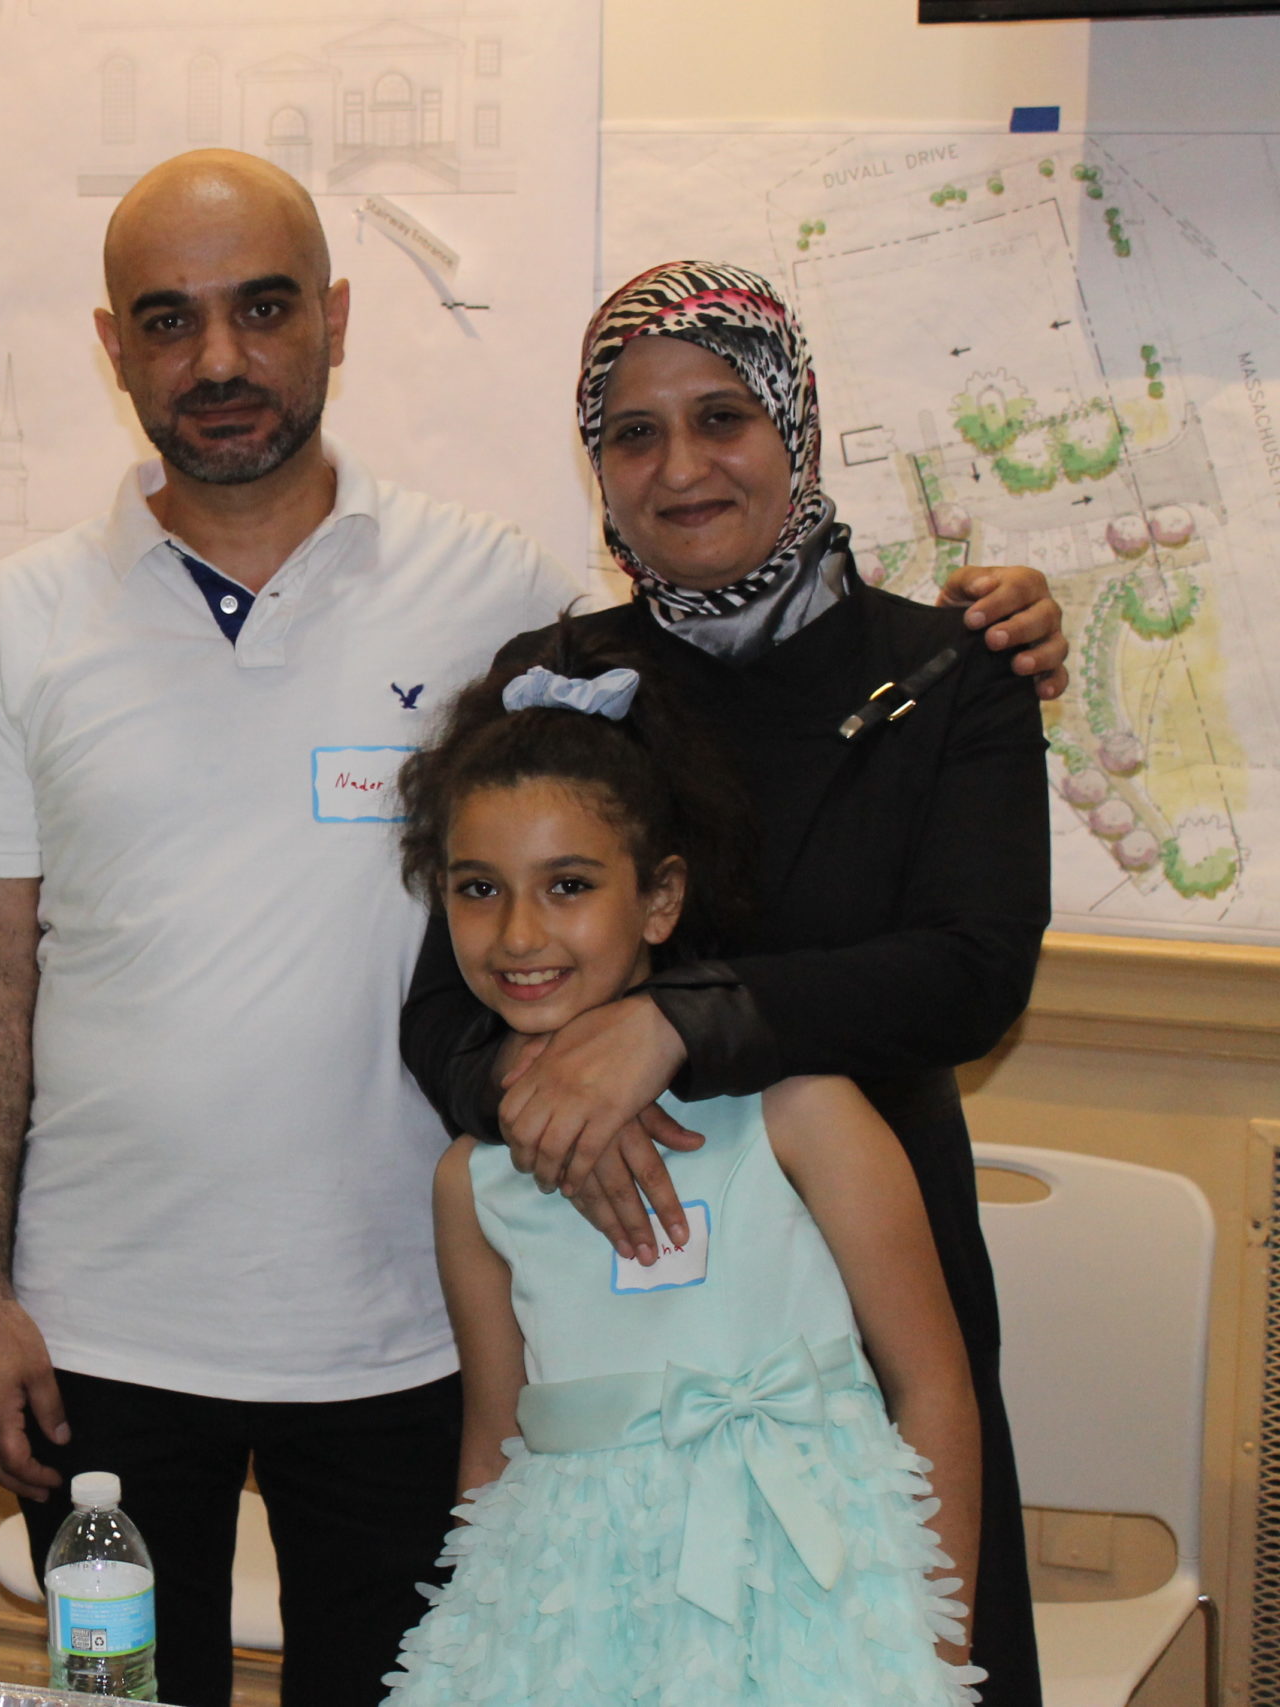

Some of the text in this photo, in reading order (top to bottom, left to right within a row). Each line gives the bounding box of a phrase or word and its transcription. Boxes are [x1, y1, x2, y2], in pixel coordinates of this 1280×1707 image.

[822, 144, 960, 190] DUVALL DRIVE
[1238, 350, 1280, 507] MASSACHUSE
[335, 772, 384, 791] Nader
